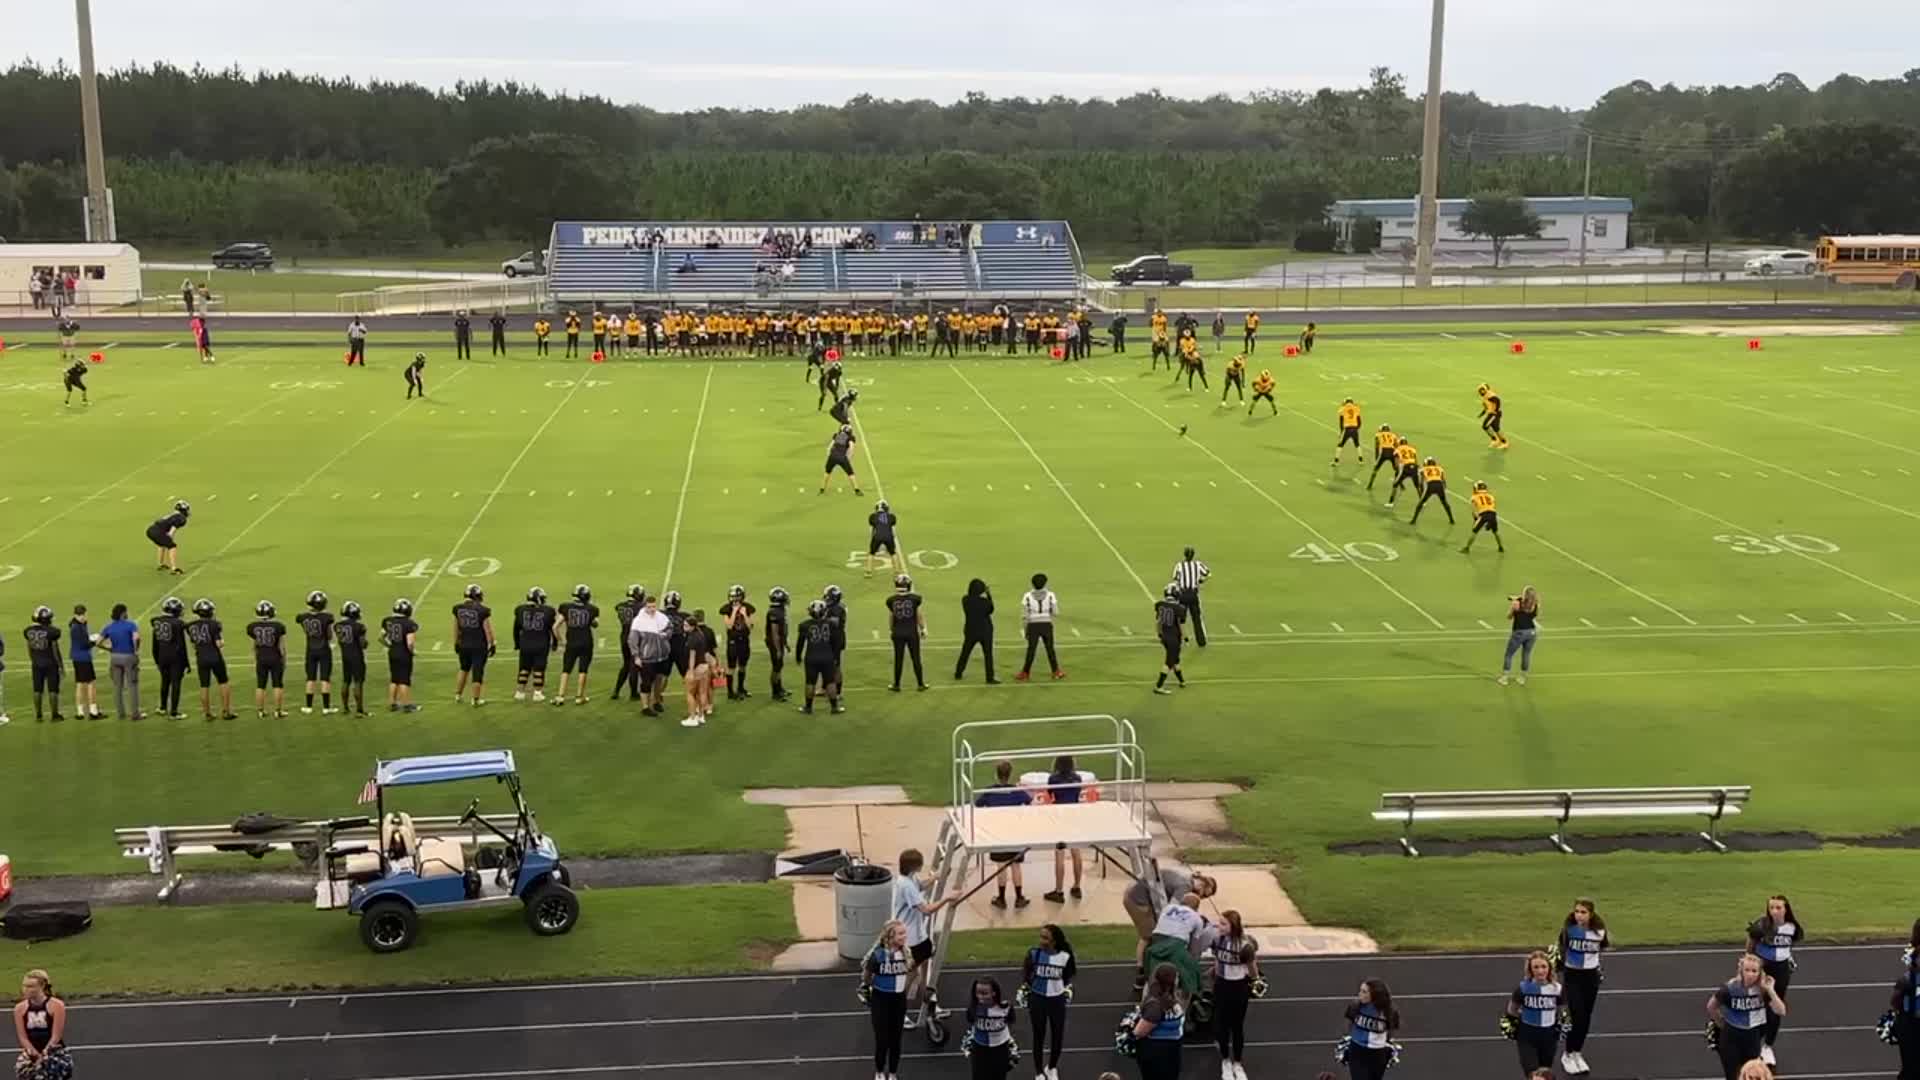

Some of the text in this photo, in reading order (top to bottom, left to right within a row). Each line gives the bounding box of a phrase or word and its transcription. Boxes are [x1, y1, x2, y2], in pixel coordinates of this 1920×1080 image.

[1288, 541, 1399, 563] 40
[1712, 533, 1841, 555] 30
[376, 556, 502, 579] 40
[845, 550, 959, 570] 50
